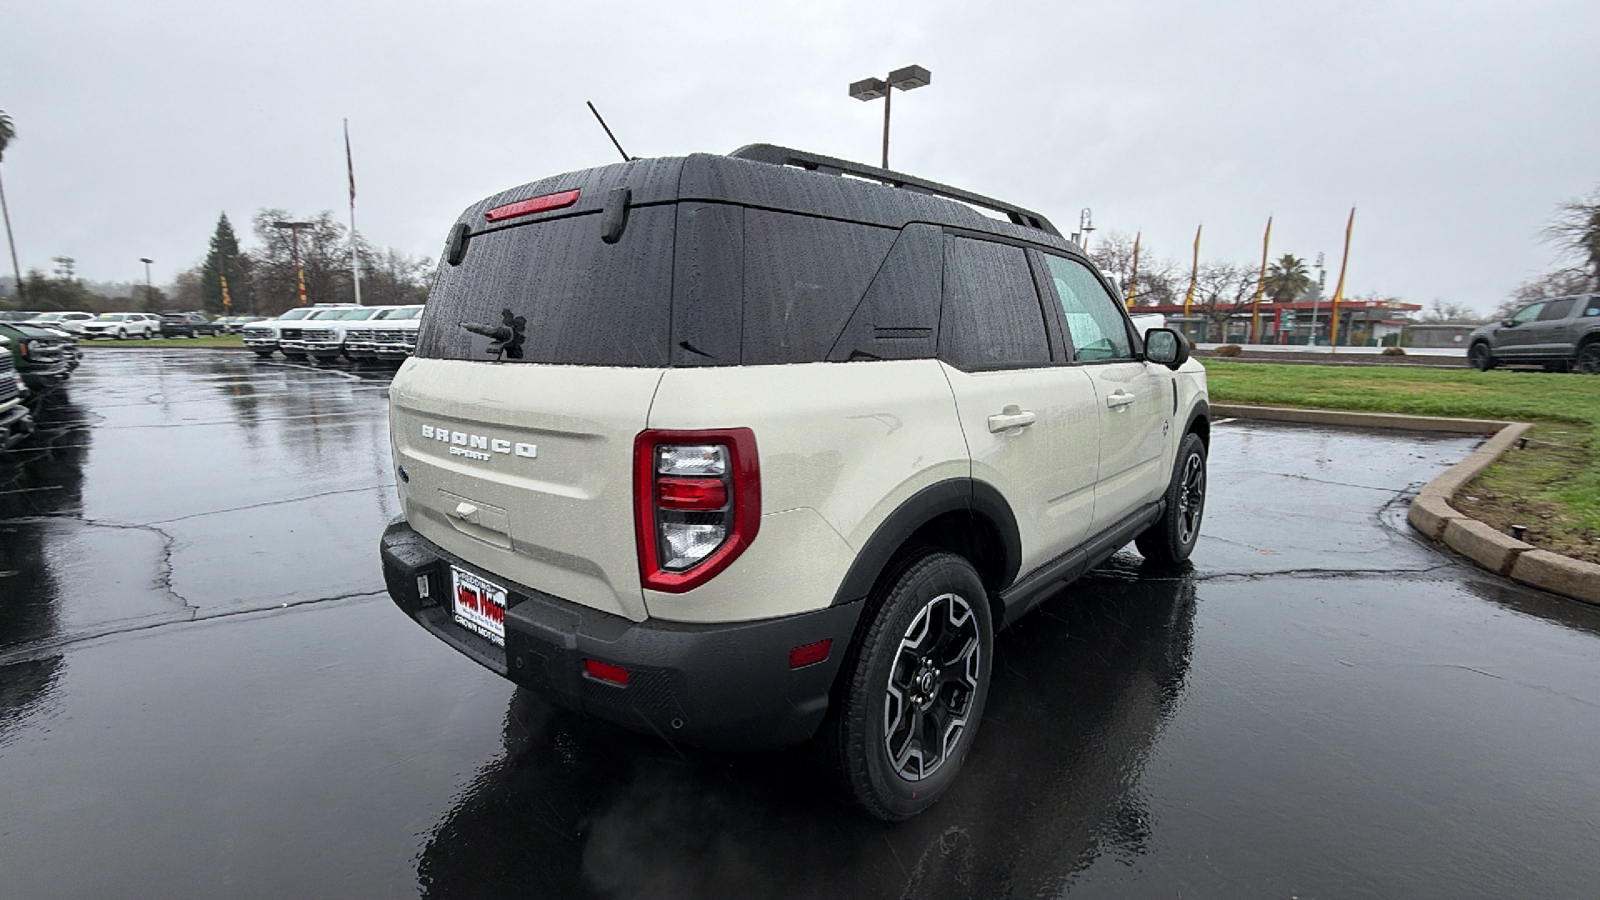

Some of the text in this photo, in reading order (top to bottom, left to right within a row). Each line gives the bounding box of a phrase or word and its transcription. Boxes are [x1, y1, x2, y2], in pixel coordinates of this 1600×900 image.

[422, 424, 537, 458] BRONCO
[449, 446, 491, 461] SPORT
[455, 614, 478, 632] CROWN
[478, 626, 505, 647] MOTORS
